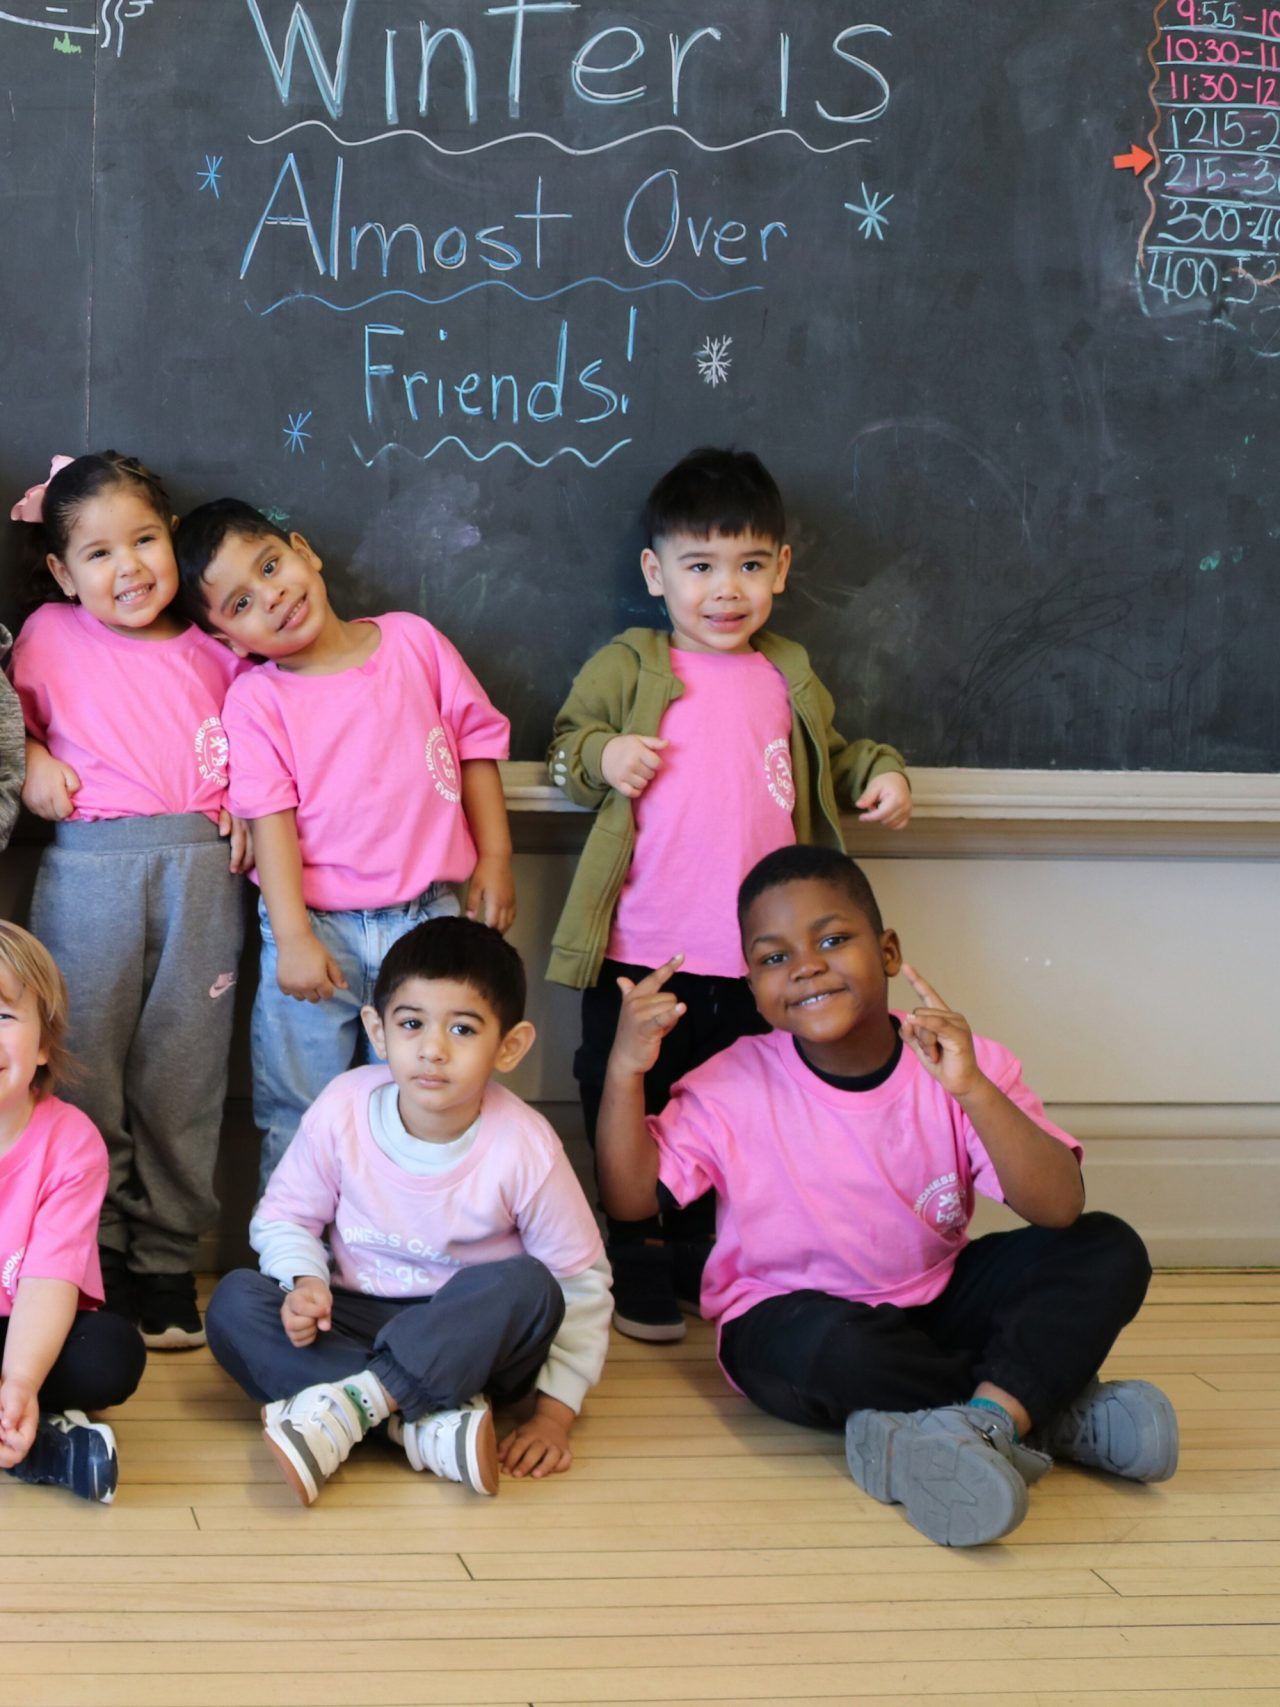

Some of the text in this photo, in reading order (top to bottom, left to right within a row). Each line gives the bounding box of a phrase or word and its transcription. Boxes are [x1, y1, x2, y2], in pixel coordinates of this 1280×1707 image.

[247, 0, 721, 124] Winter
[240, 152, 787, 279] Almost Over
[365, 306, 638, 423] Friends!
